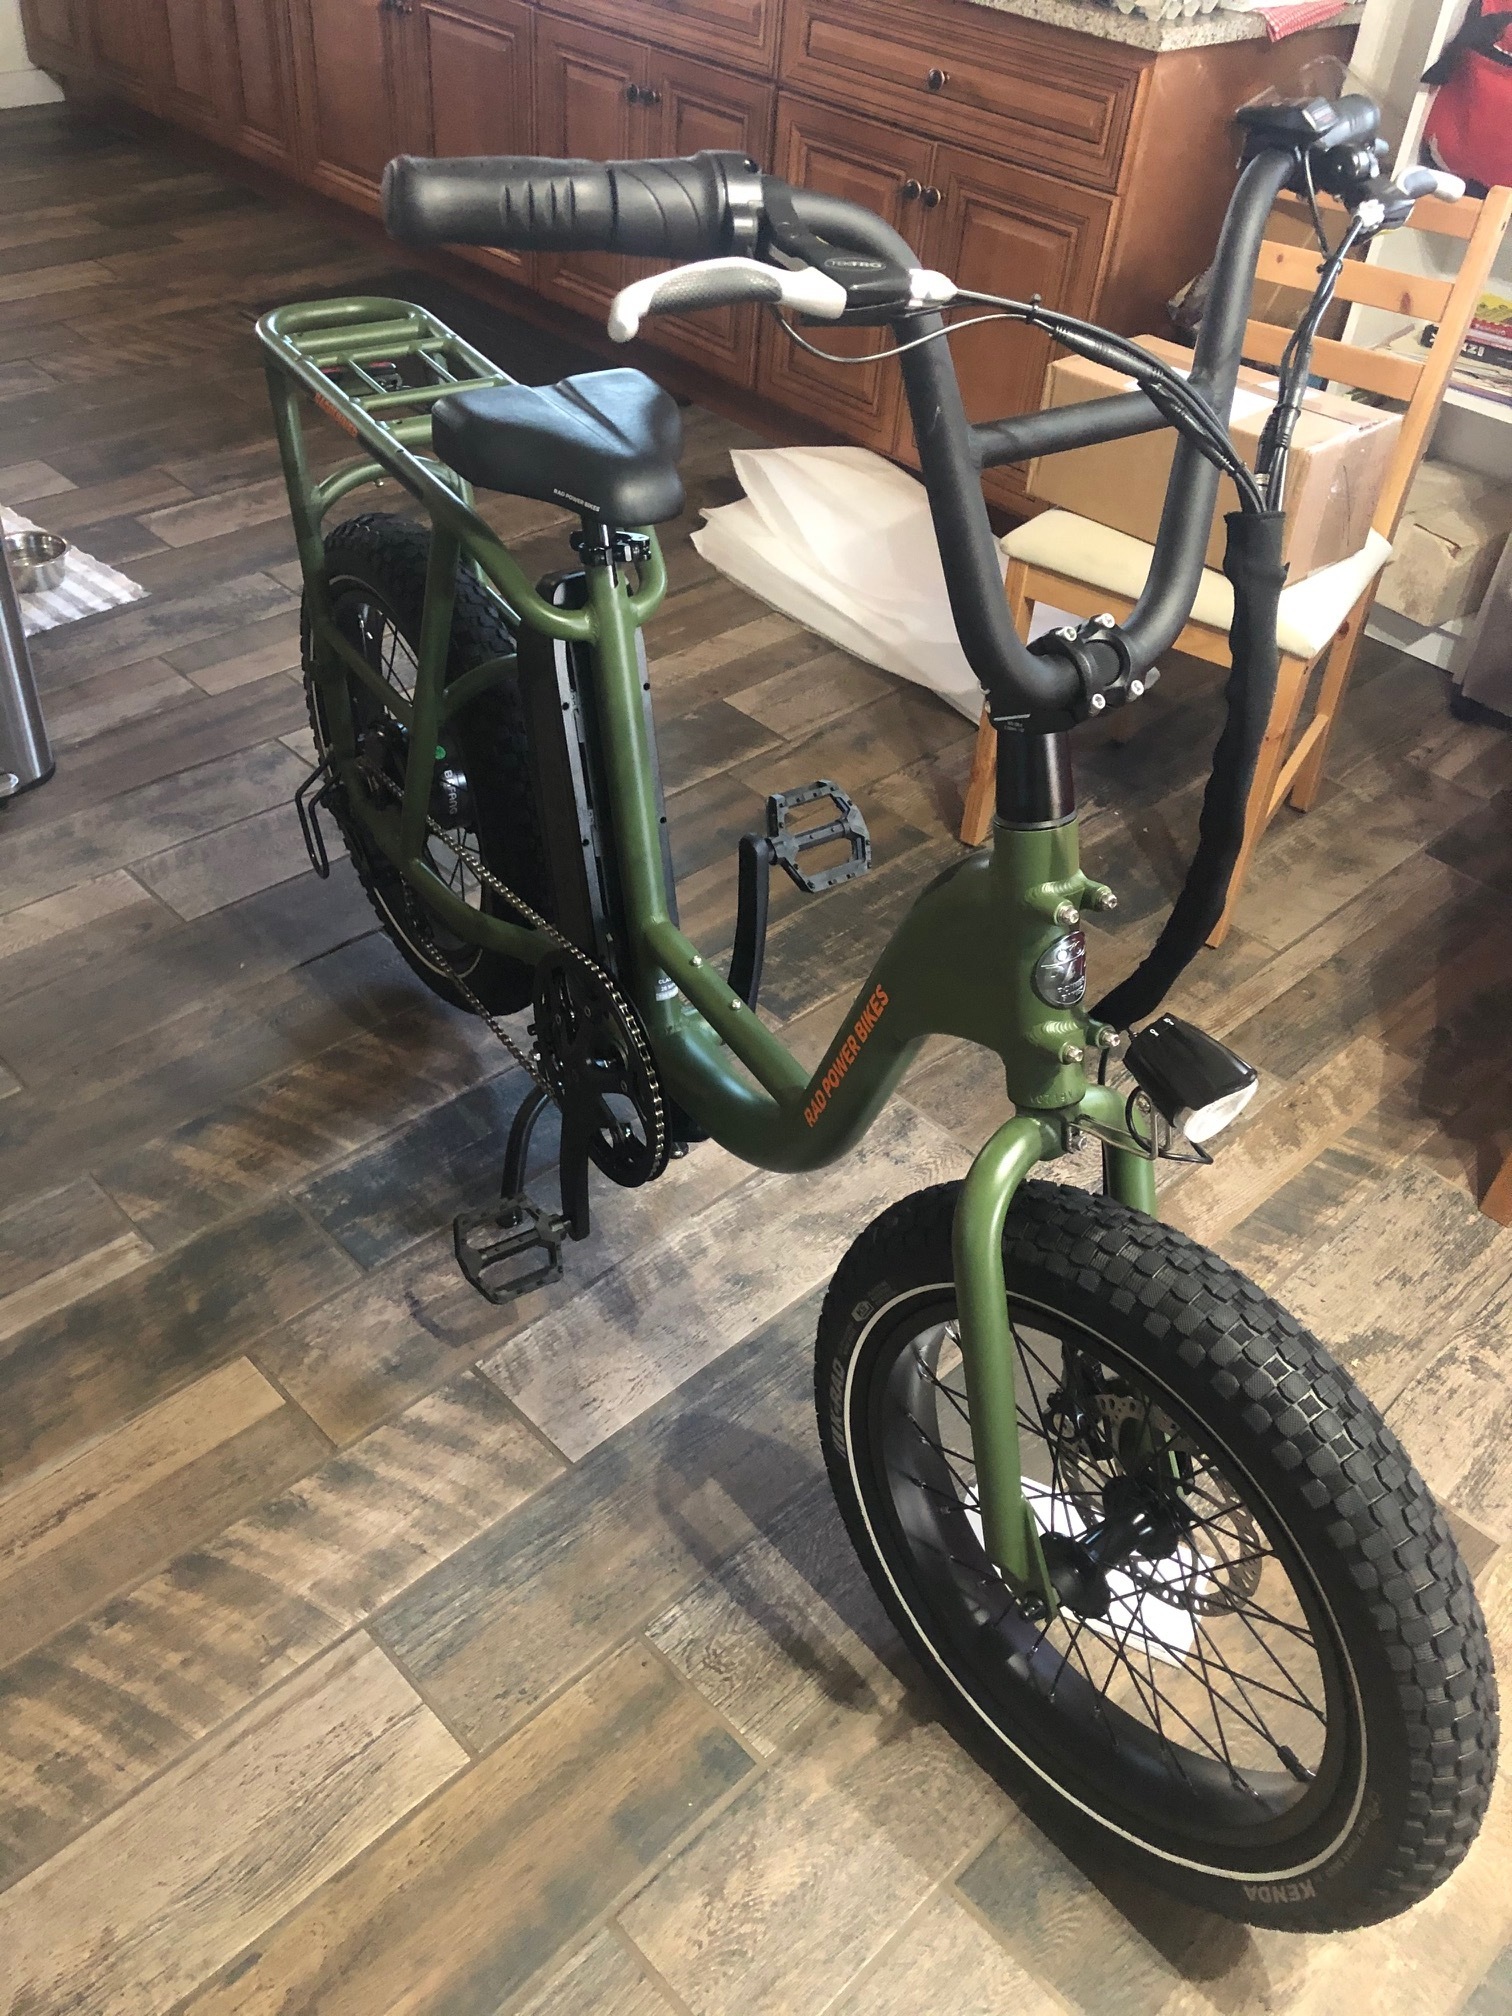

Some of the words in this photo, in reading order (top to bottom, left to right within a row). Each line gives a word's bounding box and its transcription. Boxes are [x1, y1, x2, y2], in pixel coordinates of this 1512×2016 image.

[553, 488, 565, 497] RAD
[565, 493, 584, 505] POWER
[584, 502, 600, 512] BIKES
[803, 1090, 827, 1128] RAD
[822, 1034, 861, 1098] POWER
[854, 983, 889, 1043] BIKES
[1243, 1878, 1316, 1904] KENDA
